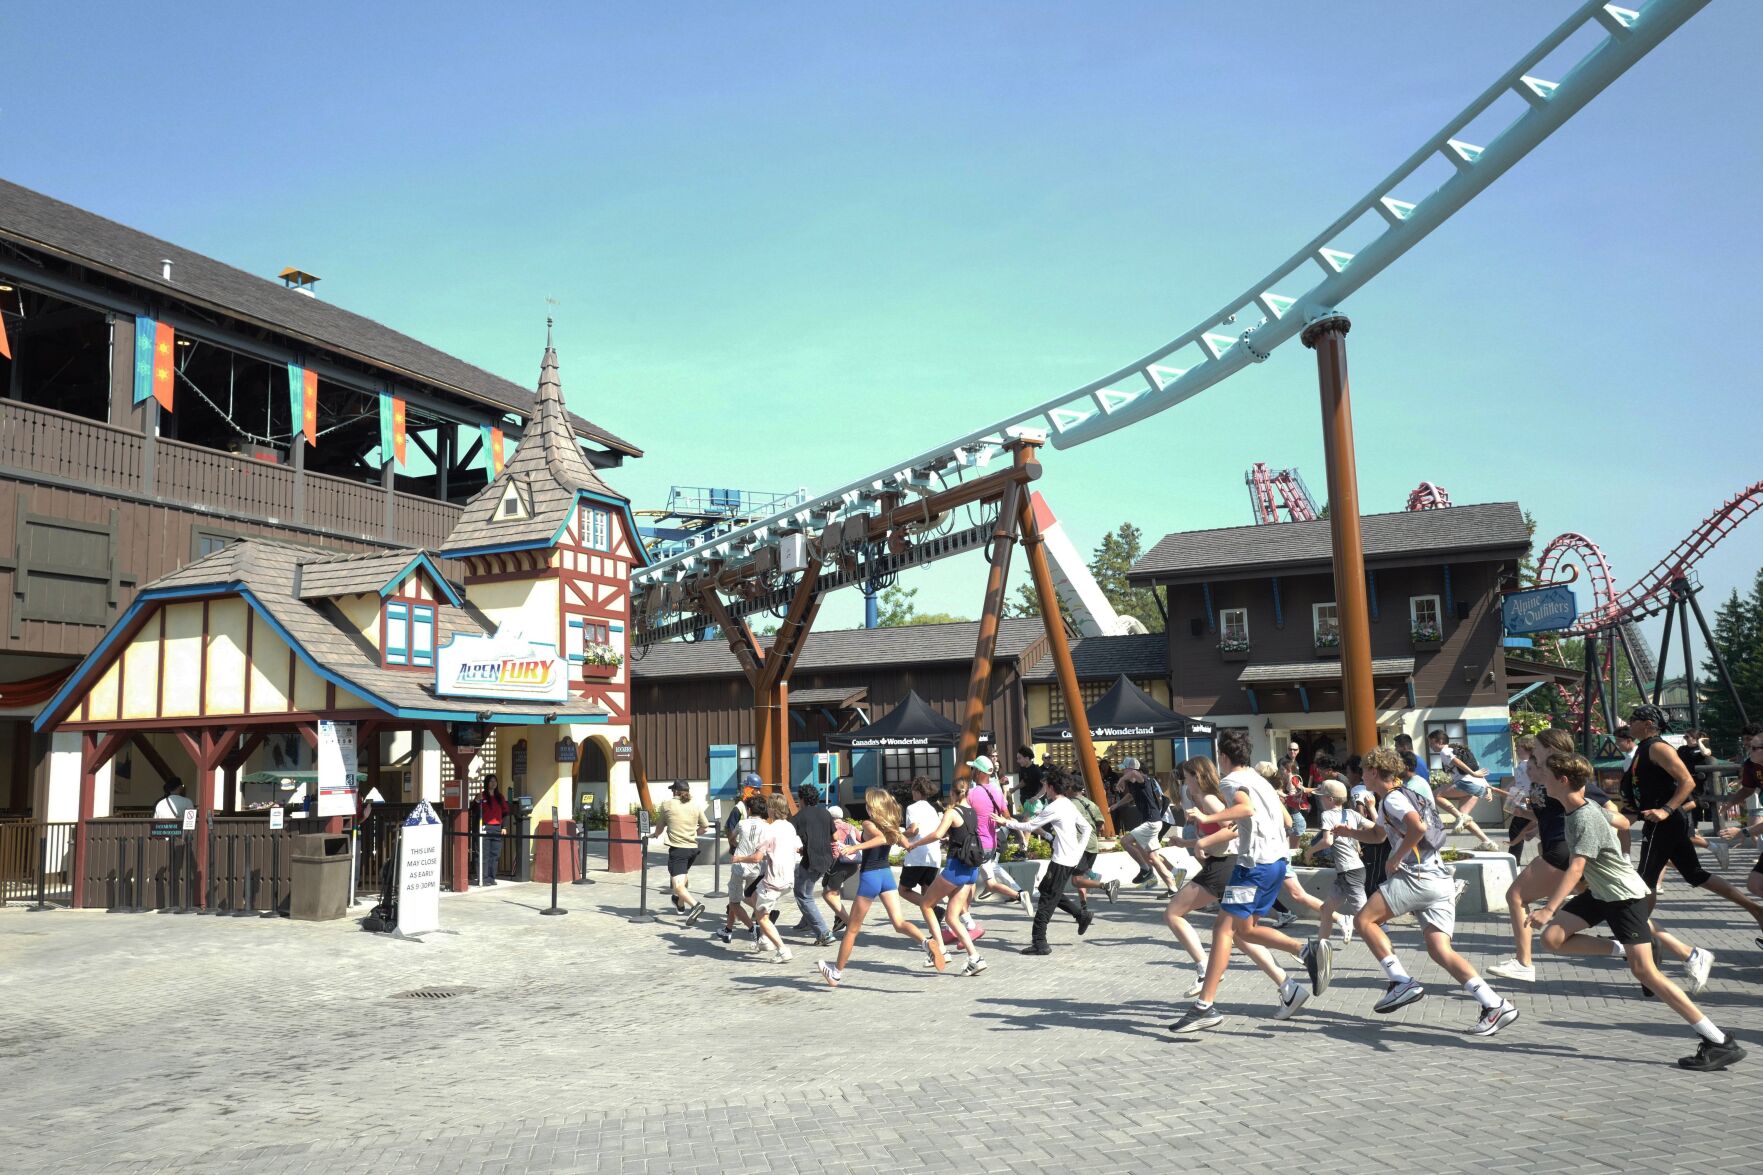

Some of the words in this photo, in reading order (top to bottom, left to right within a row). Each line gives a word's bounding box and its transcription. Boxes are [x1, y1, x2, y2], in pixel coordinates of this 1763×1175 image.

[1511, 596, 1540, 615] Alpine
[1524, 602, 1569, 626] Outfitters
[1104, 726, 1154, 736] Wonderland
[887, 737, 928, 745] Wonderland
[421, 858, 437, 866] CLOSE
